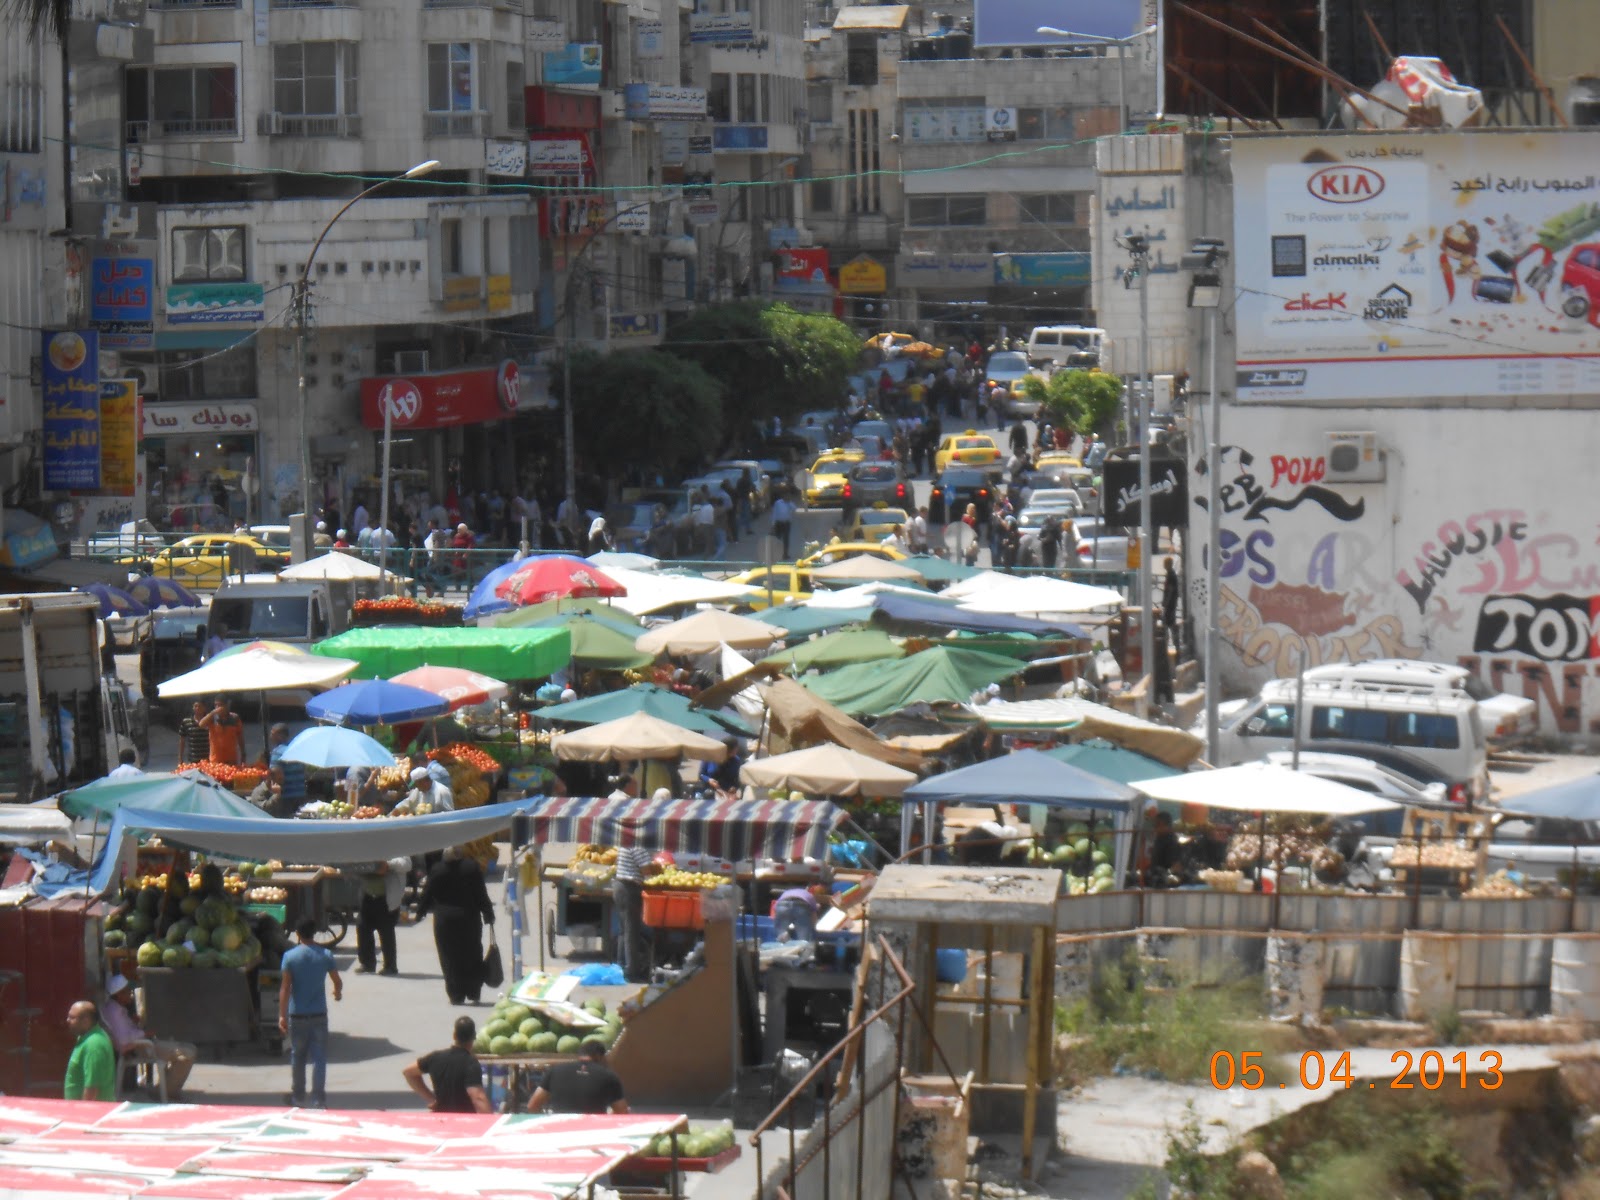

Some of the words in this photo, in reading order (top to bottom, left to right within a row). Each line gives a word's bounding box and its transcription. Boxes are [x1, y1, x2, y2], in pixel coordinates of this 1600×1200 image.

[1320, 175, 1374, 195] KIA
[1285, 211, 1306, 223] The
[1309, 211, 1345, 223] Power
[1313, 253, 1380, 266] almalki
[1363, 307, 1409, 320] HOME
[1270, 454, 1326, 488] POLO
[1397, 509, 1528, 616] LACOSTE
